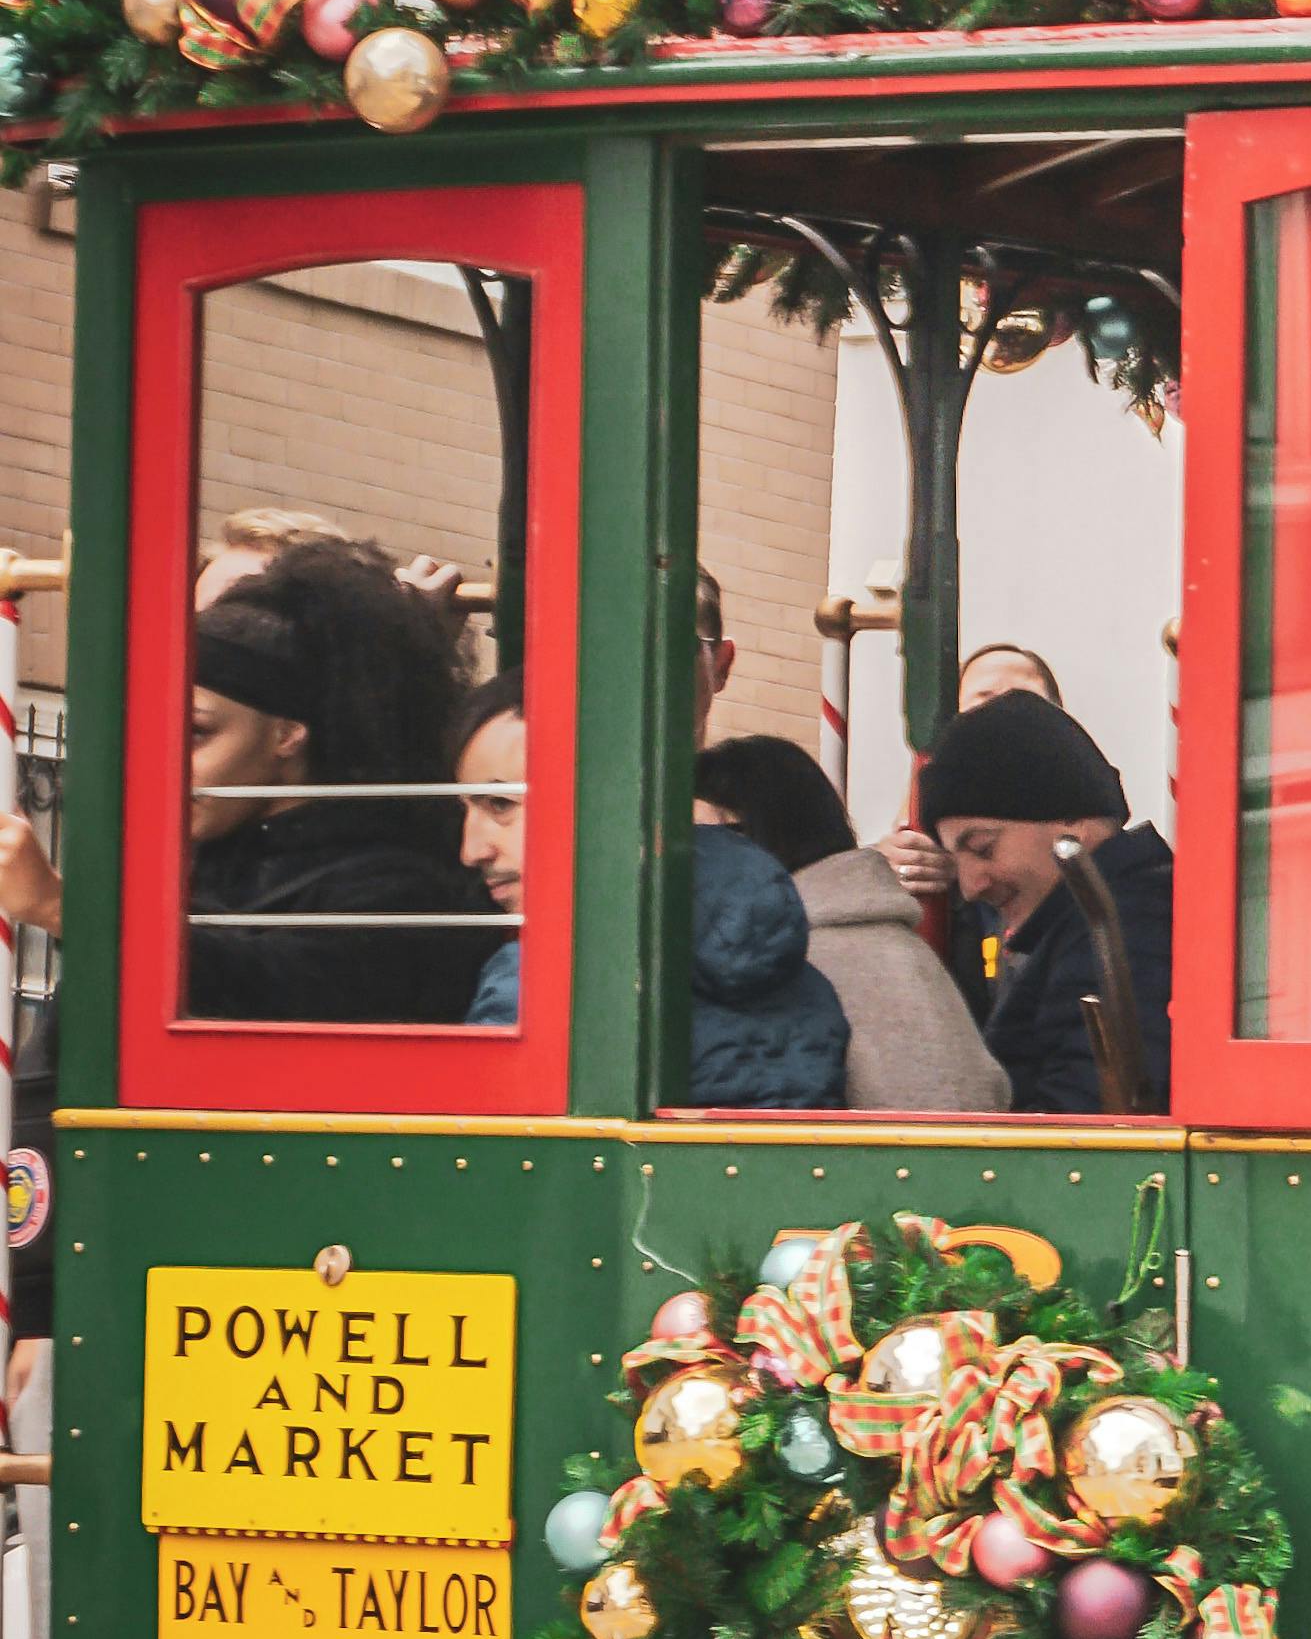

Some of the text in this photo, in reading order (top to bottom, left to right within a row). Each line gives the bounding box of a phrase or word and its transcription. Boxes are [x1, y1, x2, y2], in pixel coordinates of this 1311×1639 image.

[175, 1306, 487, 1368] POWELL
[256, 1374, 405, 1414] AND
[163, 1421, 490, 1485] MARKET
[174, 1561, 498, 1637] BAY AND TAYLOR
